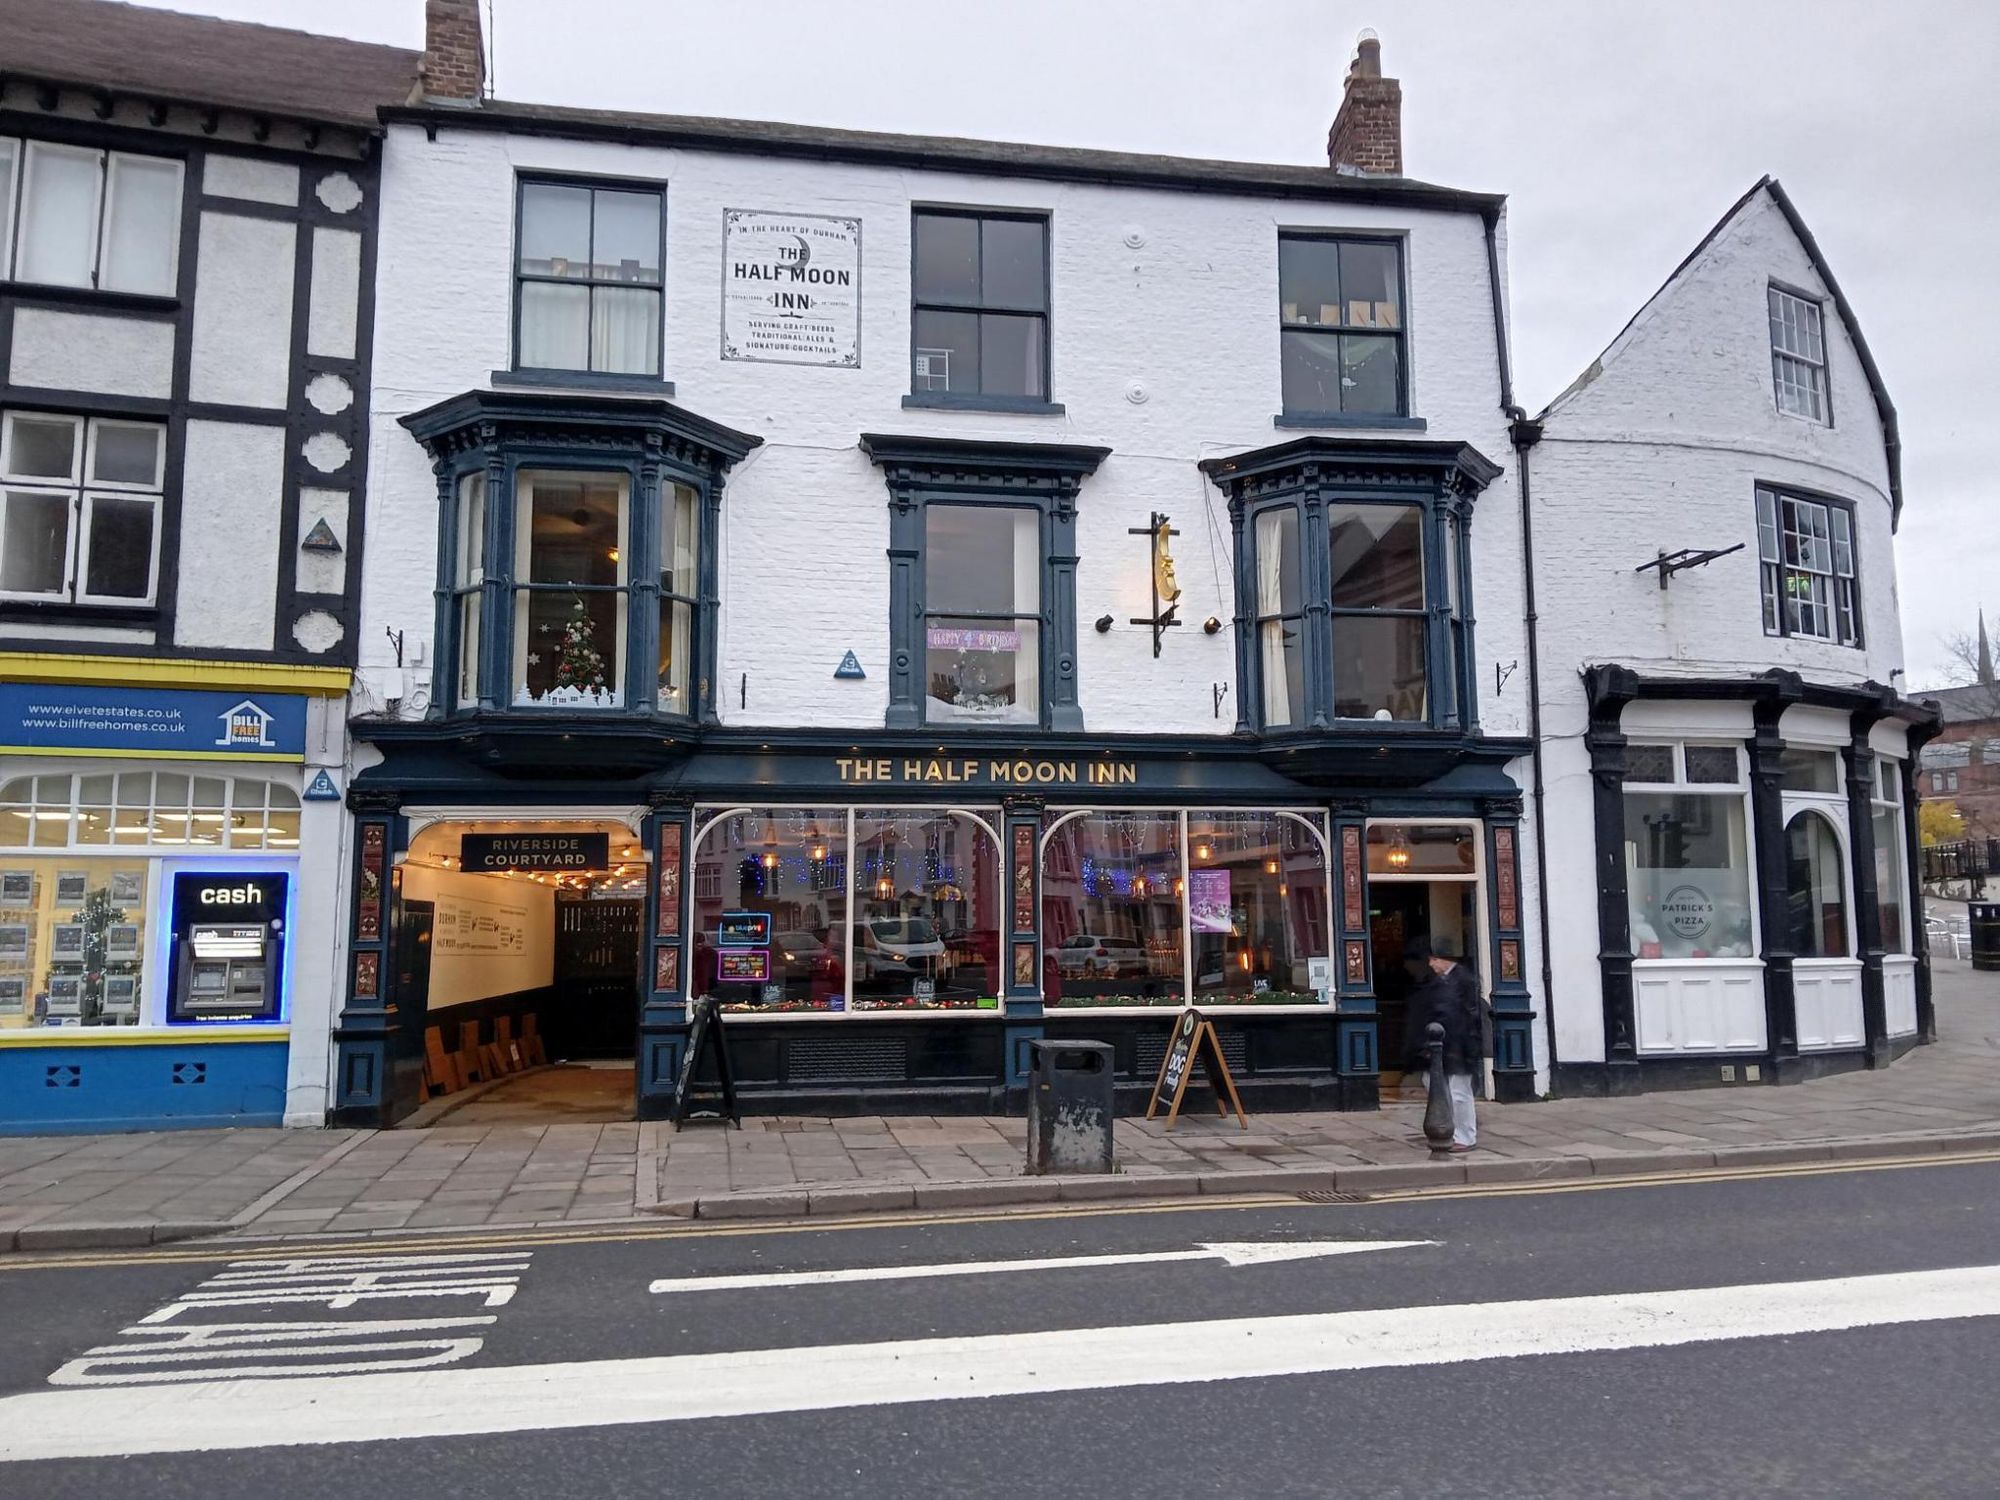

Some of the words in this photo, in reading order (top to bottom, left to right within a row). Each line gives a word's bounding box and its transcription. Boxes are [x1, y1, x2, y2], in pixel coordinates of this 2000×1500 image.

[739, 226, 747, 234] IN
[800, 227, 809, 235] OF
[813, 228, 847, 242] DURHAM
[778, 247, 808, 261] THE
[734, 262, 783, 281] HALF
[790, 267, 850, 286] MOON
[774, 292, 810, 310] INN
[748, 320, 781, 329] SERVING
[783, 322, 808, 331] CRAFT
[811, 324, 835, 333] BEERS
[752, 331, 802, 342] TRADITIONAL
[806, 334, 825, 343] ALES
[829, 336, 835, 344] &
[746, 342, 790, 351] SIGNATURE
[792, 344, 837, 354] COCKTAILS
[933, 632, 960, 645] HAPPY
[28, 703, 181, 719] www.elvetestates.co.uk
[22, 718, 185, 733] www.billfreehomes.co.uk
[233, 715, 260, 726] BILL
[232, 725, 260, 736] FREE
[231, 734, 260, 743] homes
[836, 759, 892, 781] THE
[903, 760, 979, 782] HALF
[990, 761, 1077, 783] MOON
[1088, 763, 1136, 784] INN
[492, 839, 579, 850] RIVERSIDE
[484, 854, 586, 866] COURTYARD
[200, 882, 262, 904] cash
[1675, 916, 1704, 925] PIZZA
